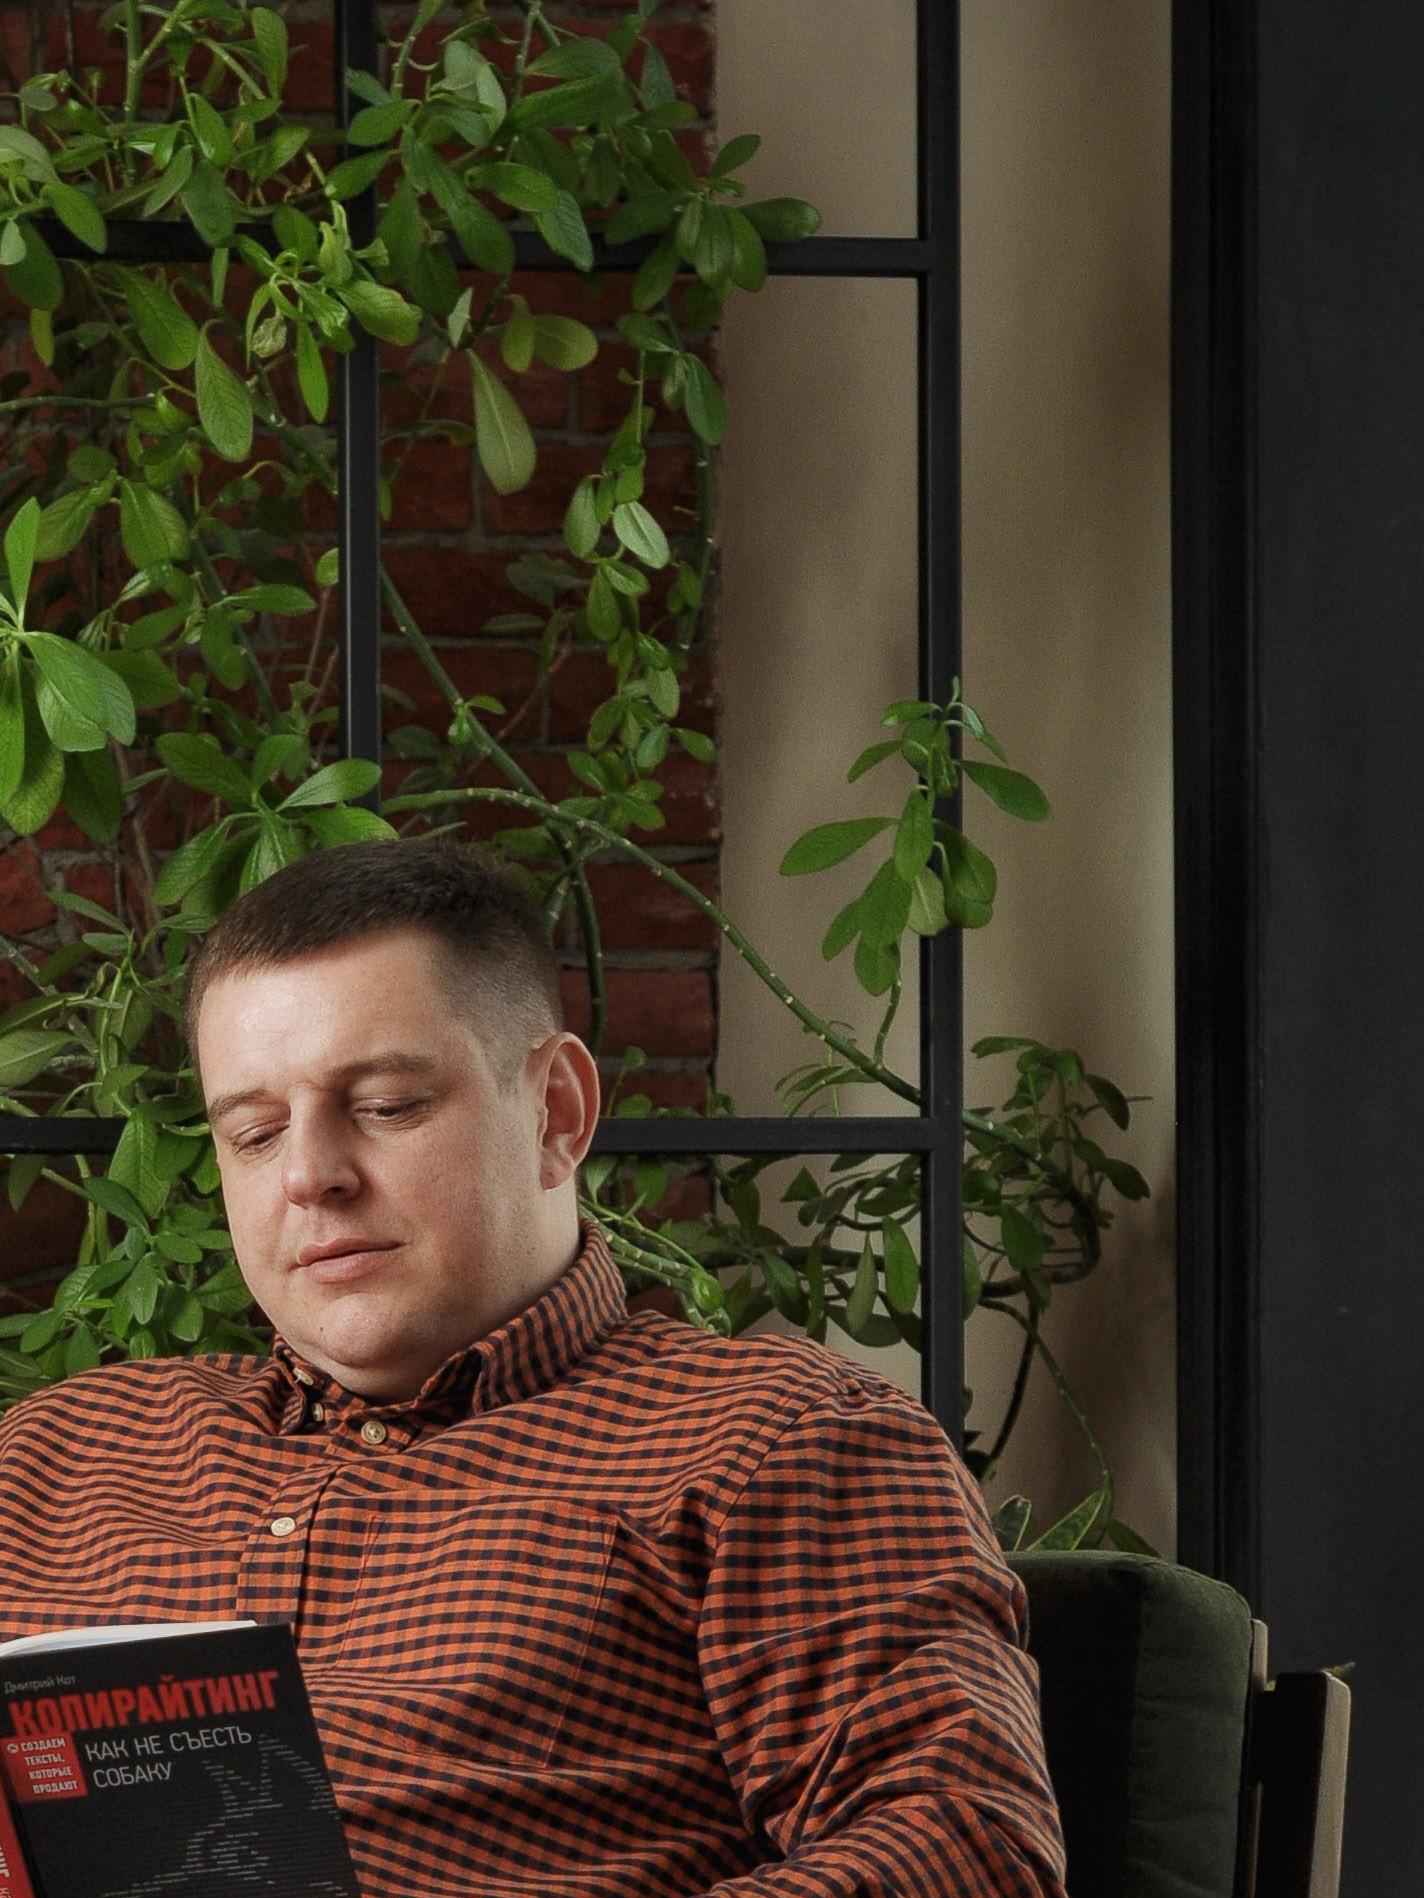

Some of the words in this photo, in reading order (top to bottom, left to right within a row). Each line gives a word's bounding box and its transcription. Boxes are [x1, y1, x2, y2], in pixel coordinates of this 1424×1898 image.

[4, 1678, 53, 1694] Дмитрий
[55, 1674, 76, 1687] Кот
[9, 1670, 280, 1738] КОПИРАЙТИНГ
[20, 1737, 66, 1752] СОЗДАЕМ
[85, 1740, 128, 1762] КАК
[134, 1734, 164, 1756] НЕ
[170, 1725, 253, 1752] СЪЕСТЬ
[28, 1766, 73, 1781] КОТОРЫЕ
[93, 1762, 173, 1788] СОБАКУ
[33, 1780, 78, 1795] ПРОДАЮТ
